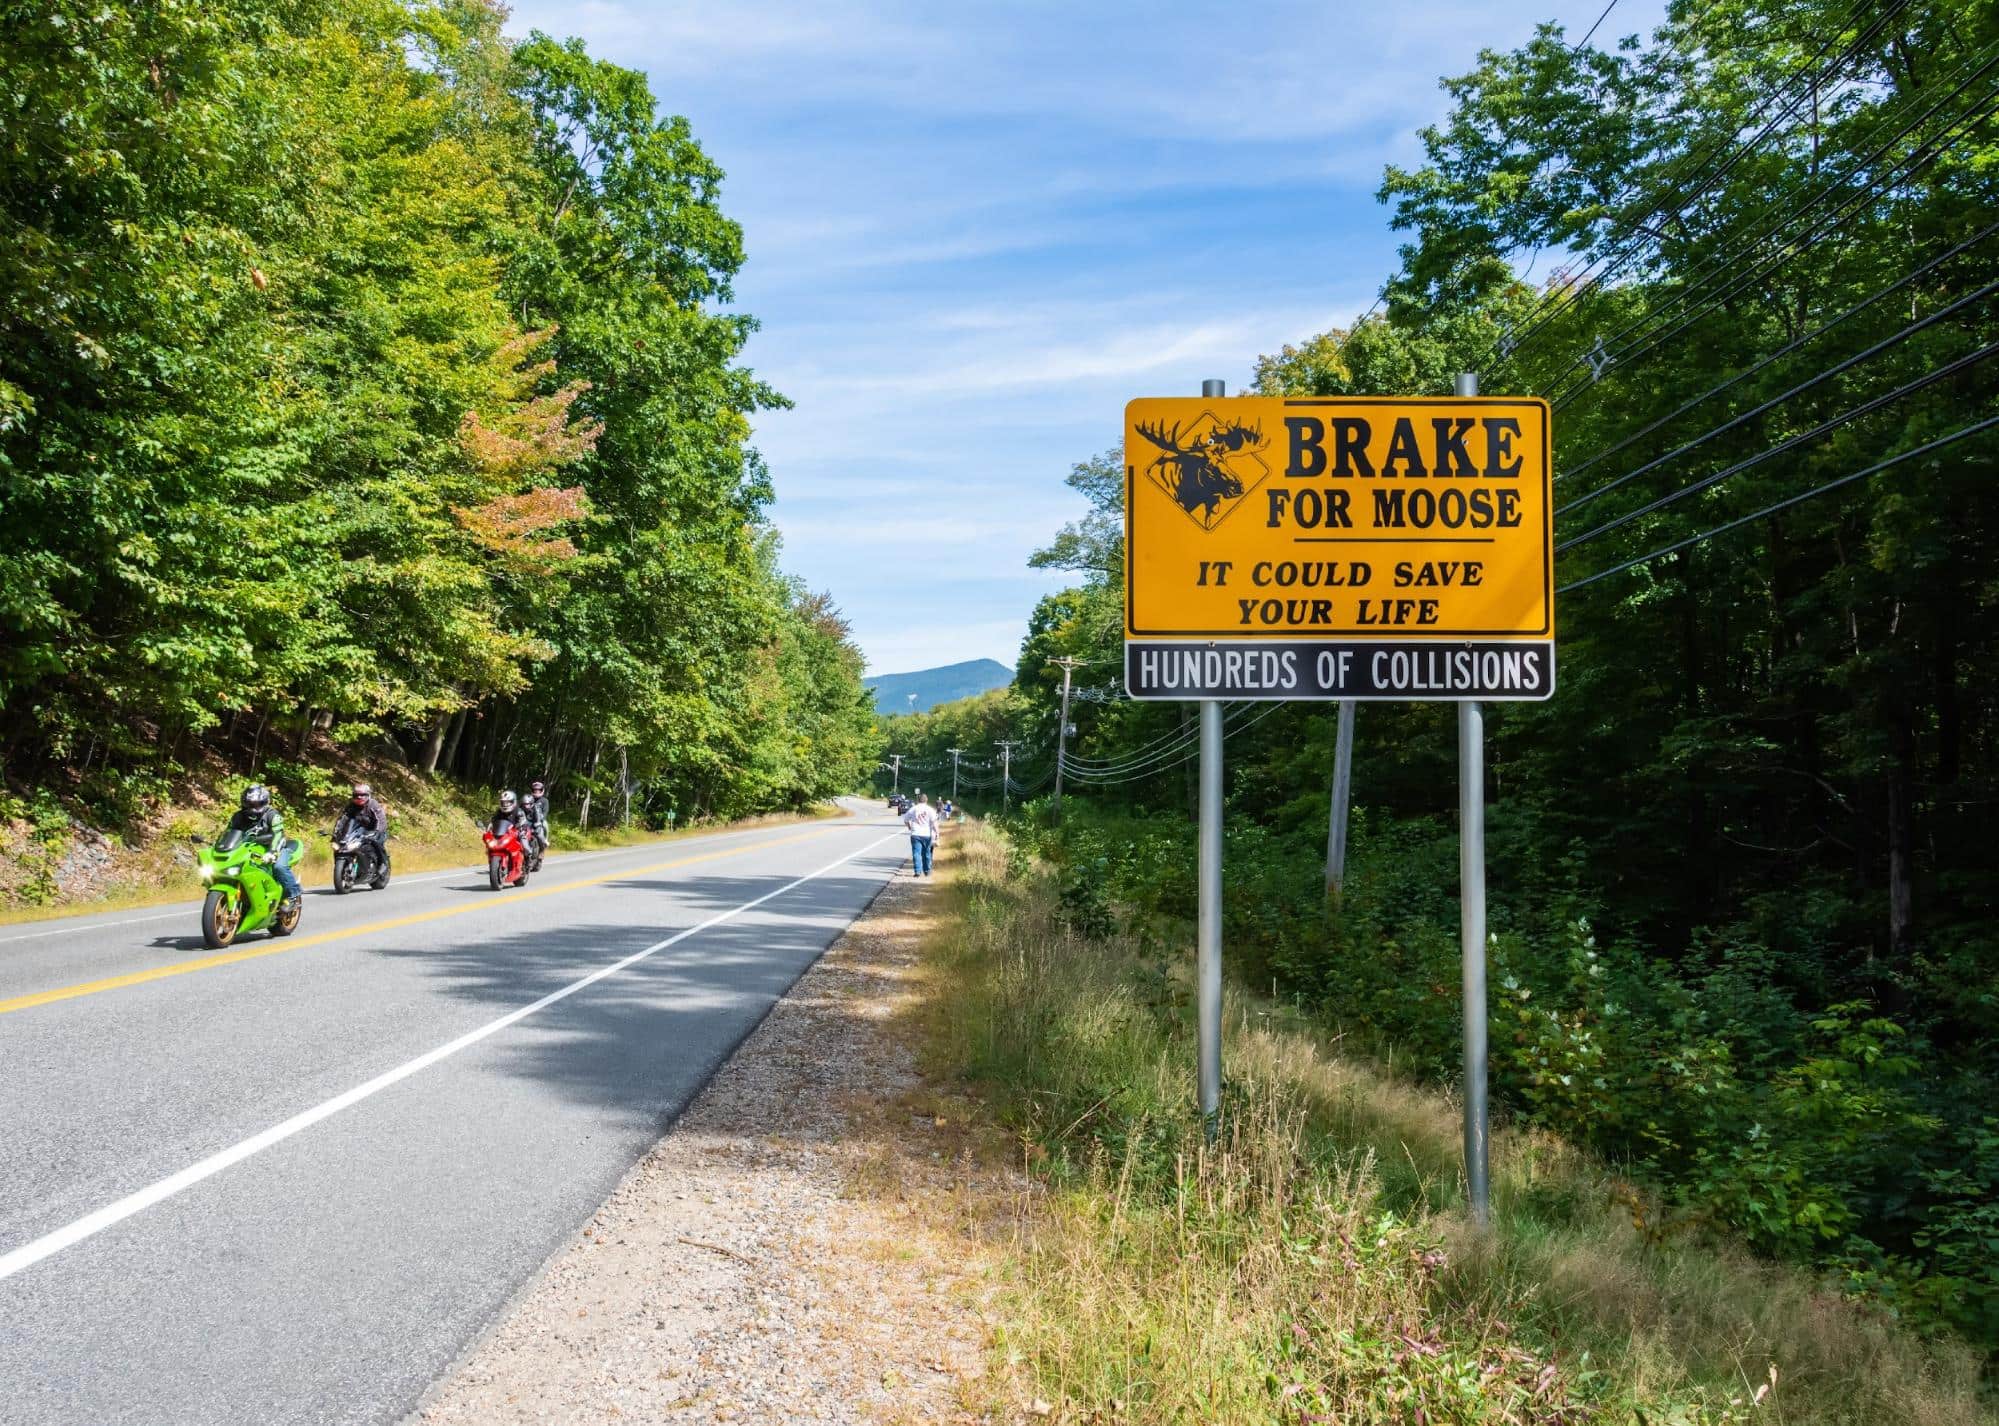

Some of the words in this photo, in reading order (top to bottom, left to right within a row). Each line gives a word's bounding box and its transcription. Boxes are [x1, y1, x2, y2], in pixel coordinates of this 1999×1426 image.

[1283, 416, 1523, 478] BRAKE
[1266, 488, 1353, 529] FOR
[1373, 488, 1522, 529] MOOSE
[1197, 561, 1233, 587] IT
[1252, 561, 1372, 587] COULD
[1393, 561, 1484, 587] SAVE
[1238, 599, 1333, 625] YOUR
[1356, 599, 1440, 625] LIFE
[1140, 650, 1298, 689] HUNDREDS
[1316, 650, 1354, 689] OF
[1371, 650, 1540, 689] COLLISIONS
